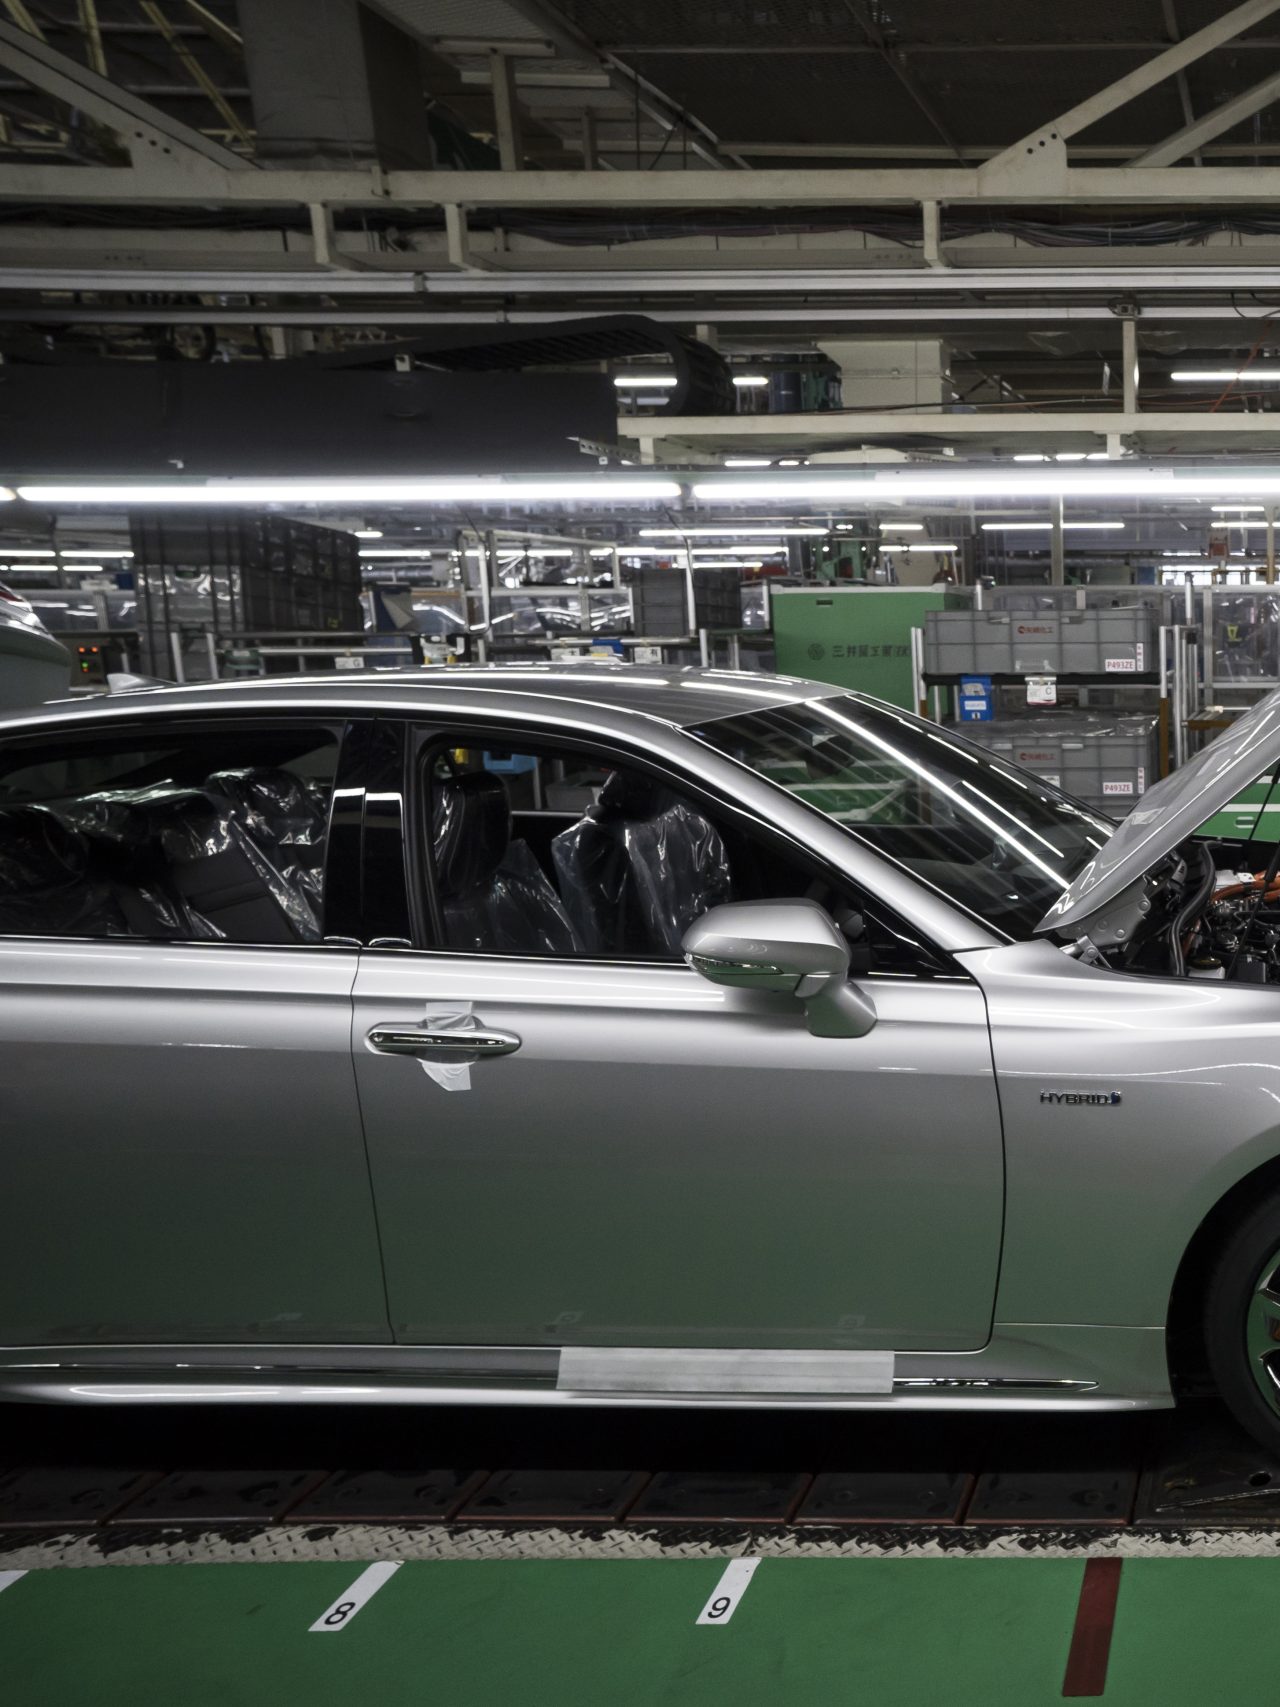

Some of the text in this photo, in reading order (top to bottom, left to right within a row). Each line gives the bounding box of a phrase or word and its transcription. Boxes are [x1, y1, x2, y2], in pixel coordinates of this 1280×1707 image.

[1040, 1091, 1109, 1105] HYBRID
[324, 1601, 356, 1625] 8
[707, 1597, 731, 1618] 9
